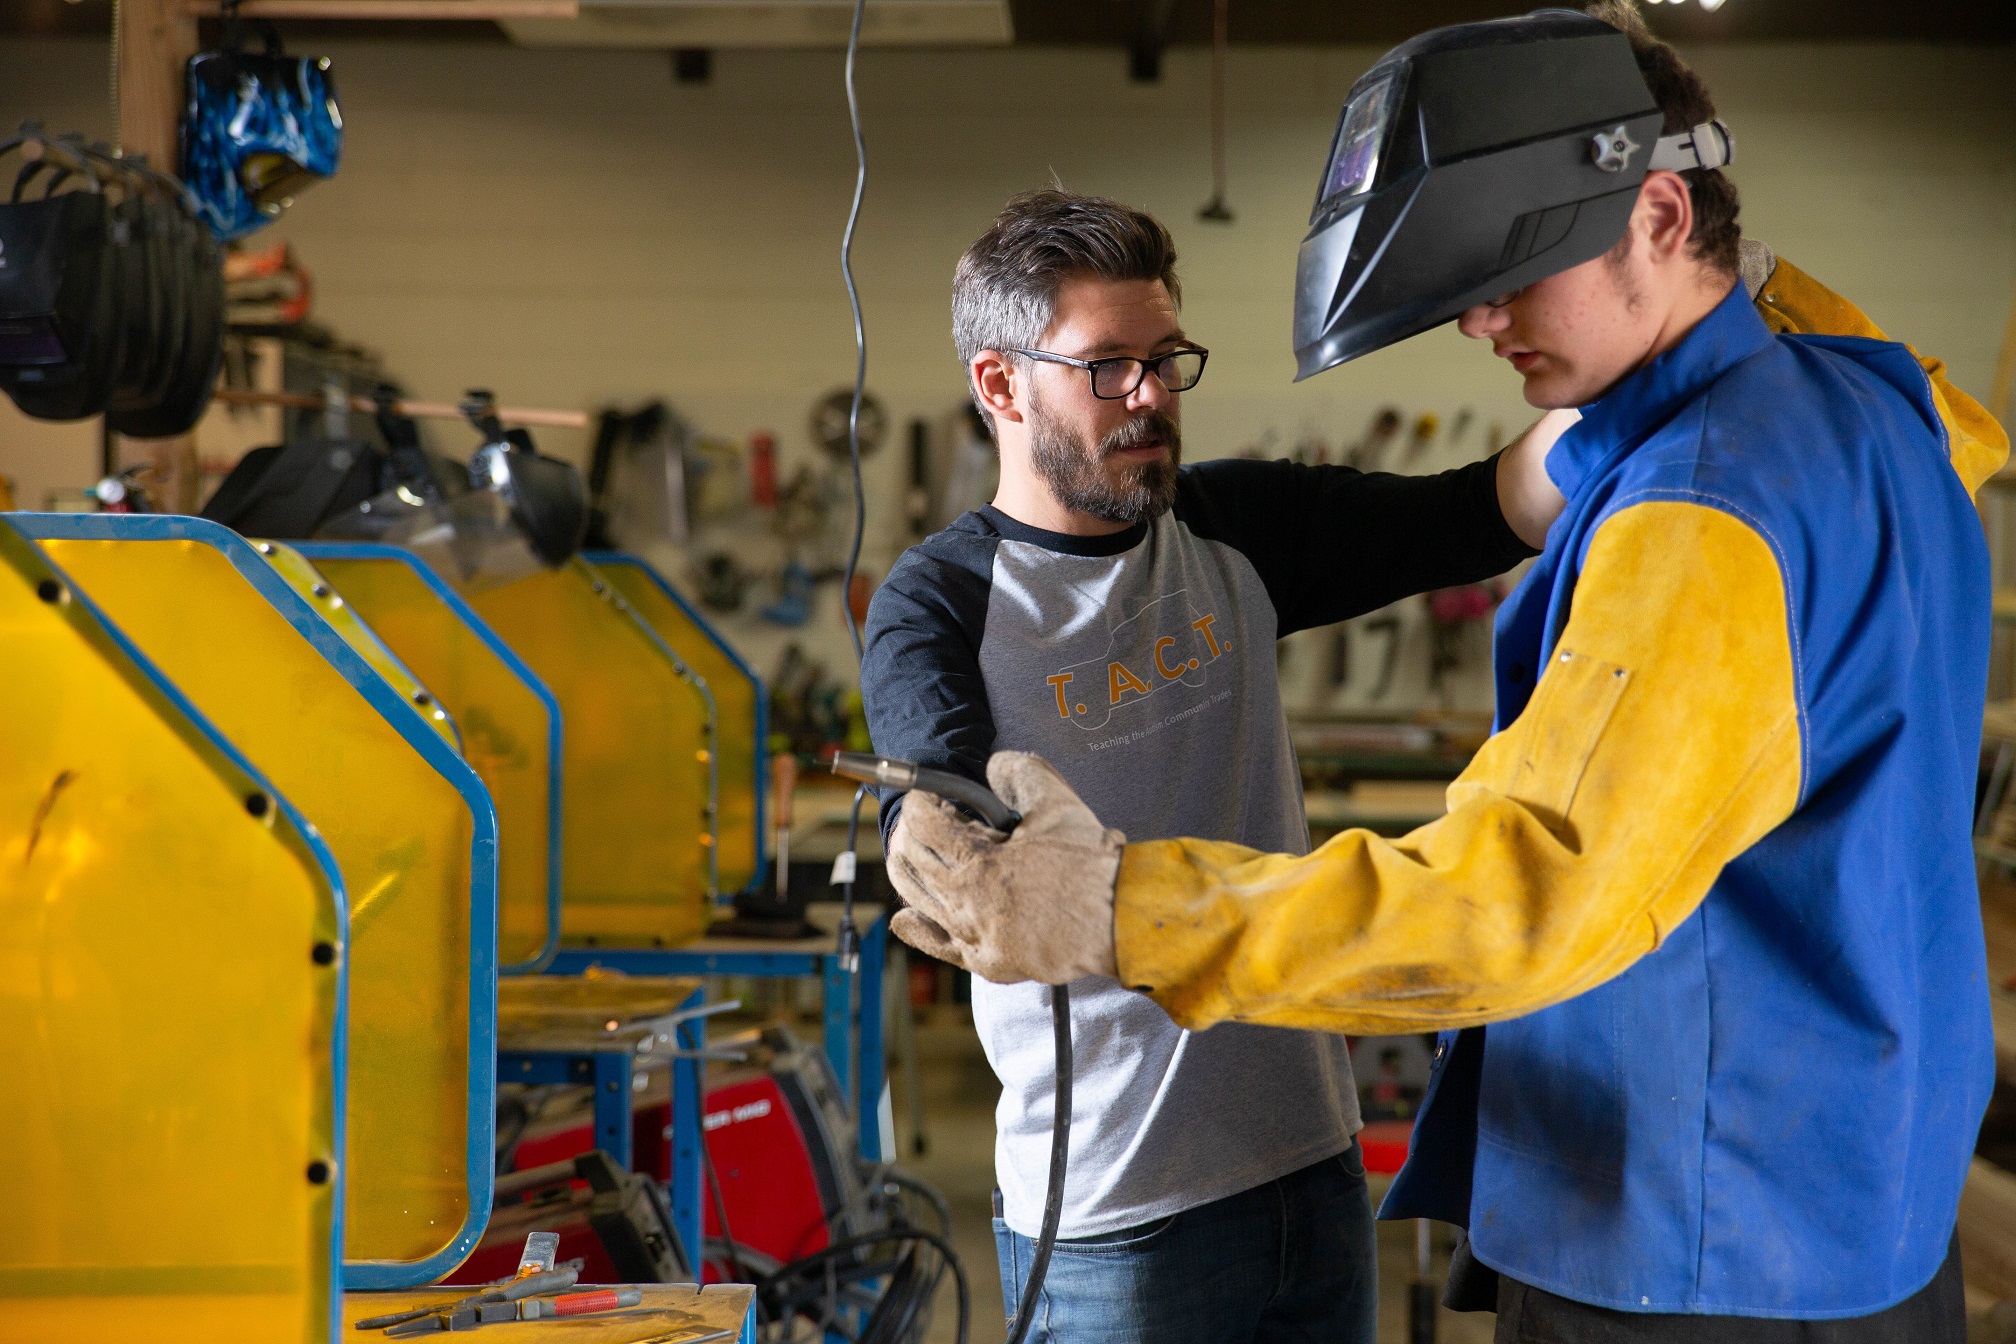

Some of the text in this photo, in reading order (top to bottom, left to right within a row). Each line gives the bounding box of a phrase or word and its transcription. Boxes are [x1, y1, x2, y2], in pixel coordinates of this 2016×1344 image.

[1087, 734, 1130, 752] Teaching
[1132, 731, 1145, 740] the
[1210, 689, 1232, 704] Trades
